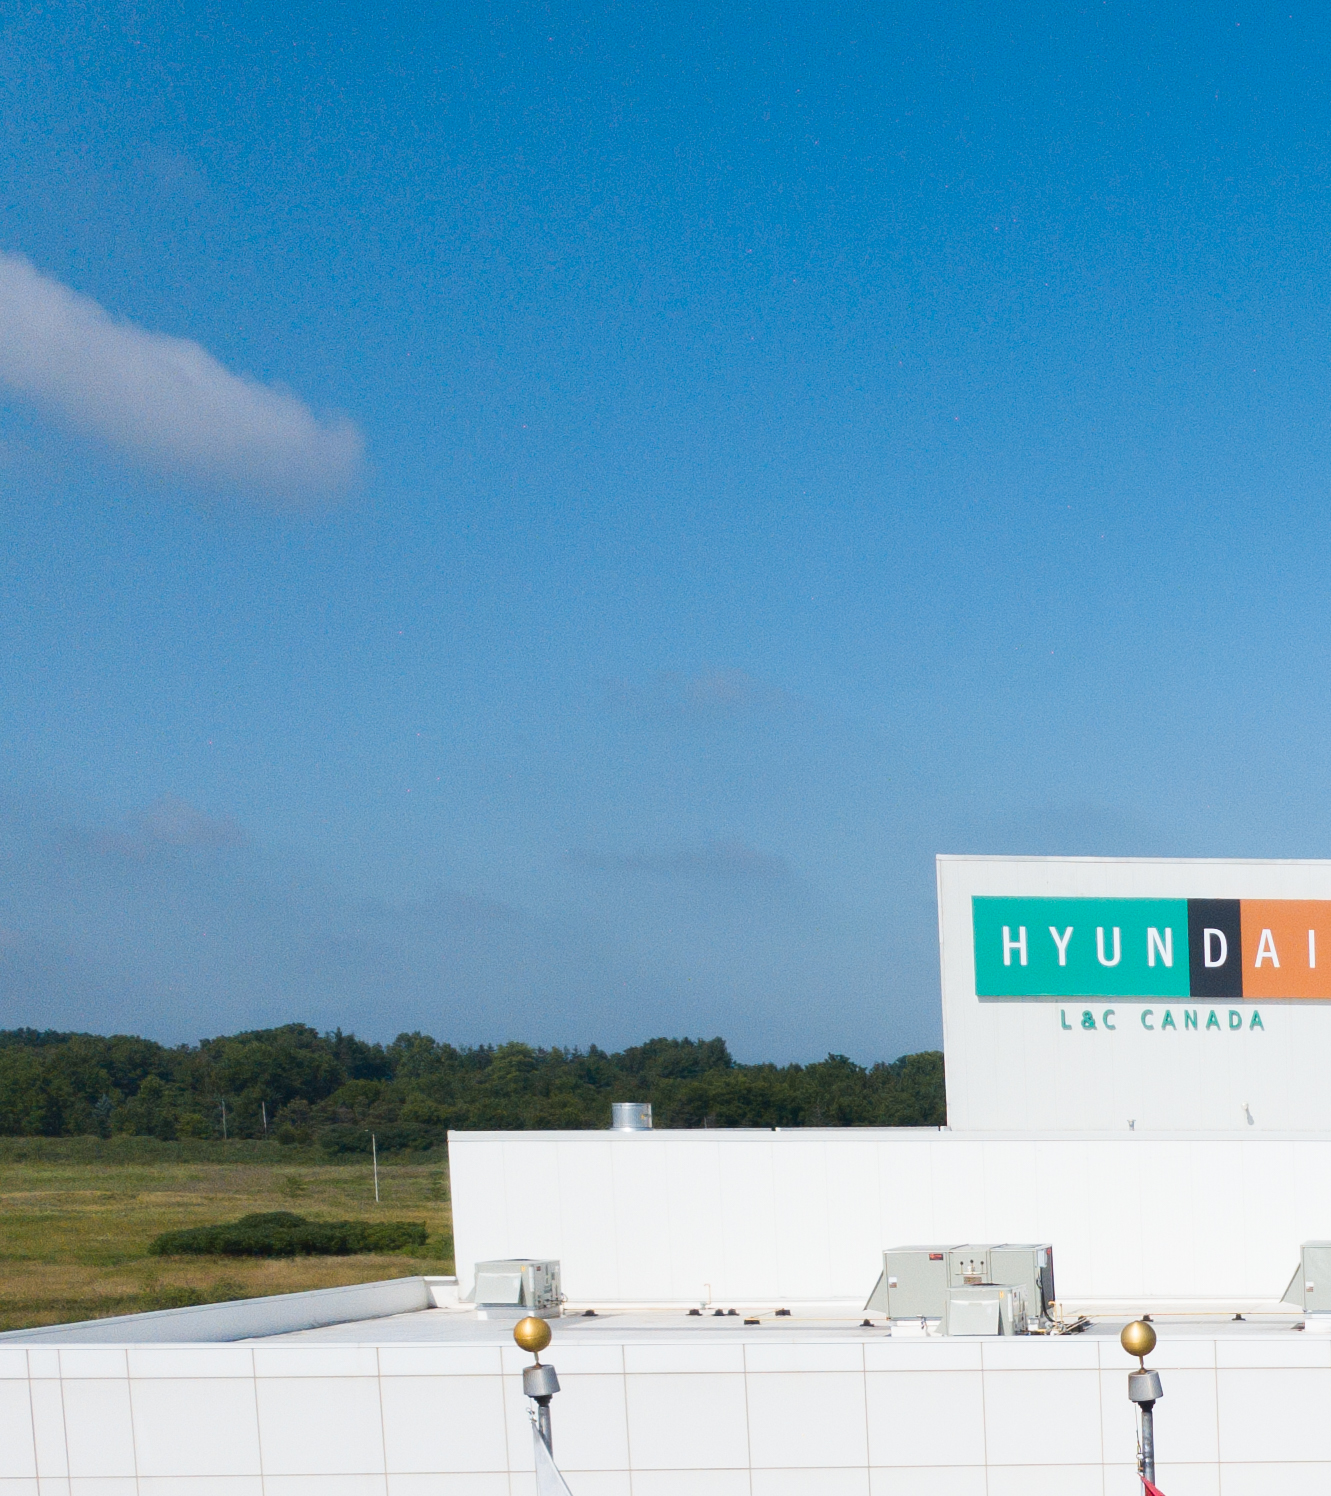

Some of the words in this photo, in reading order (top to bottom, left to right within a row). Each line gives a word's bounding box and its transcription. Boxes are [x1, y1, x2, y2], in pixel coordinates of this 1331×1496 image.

[1002, 926, 1316, 969] HYUNDAI
[1060, 1009, 1117, 1030] L&C
[1140, 1009, 1265, 1031] CANADA
